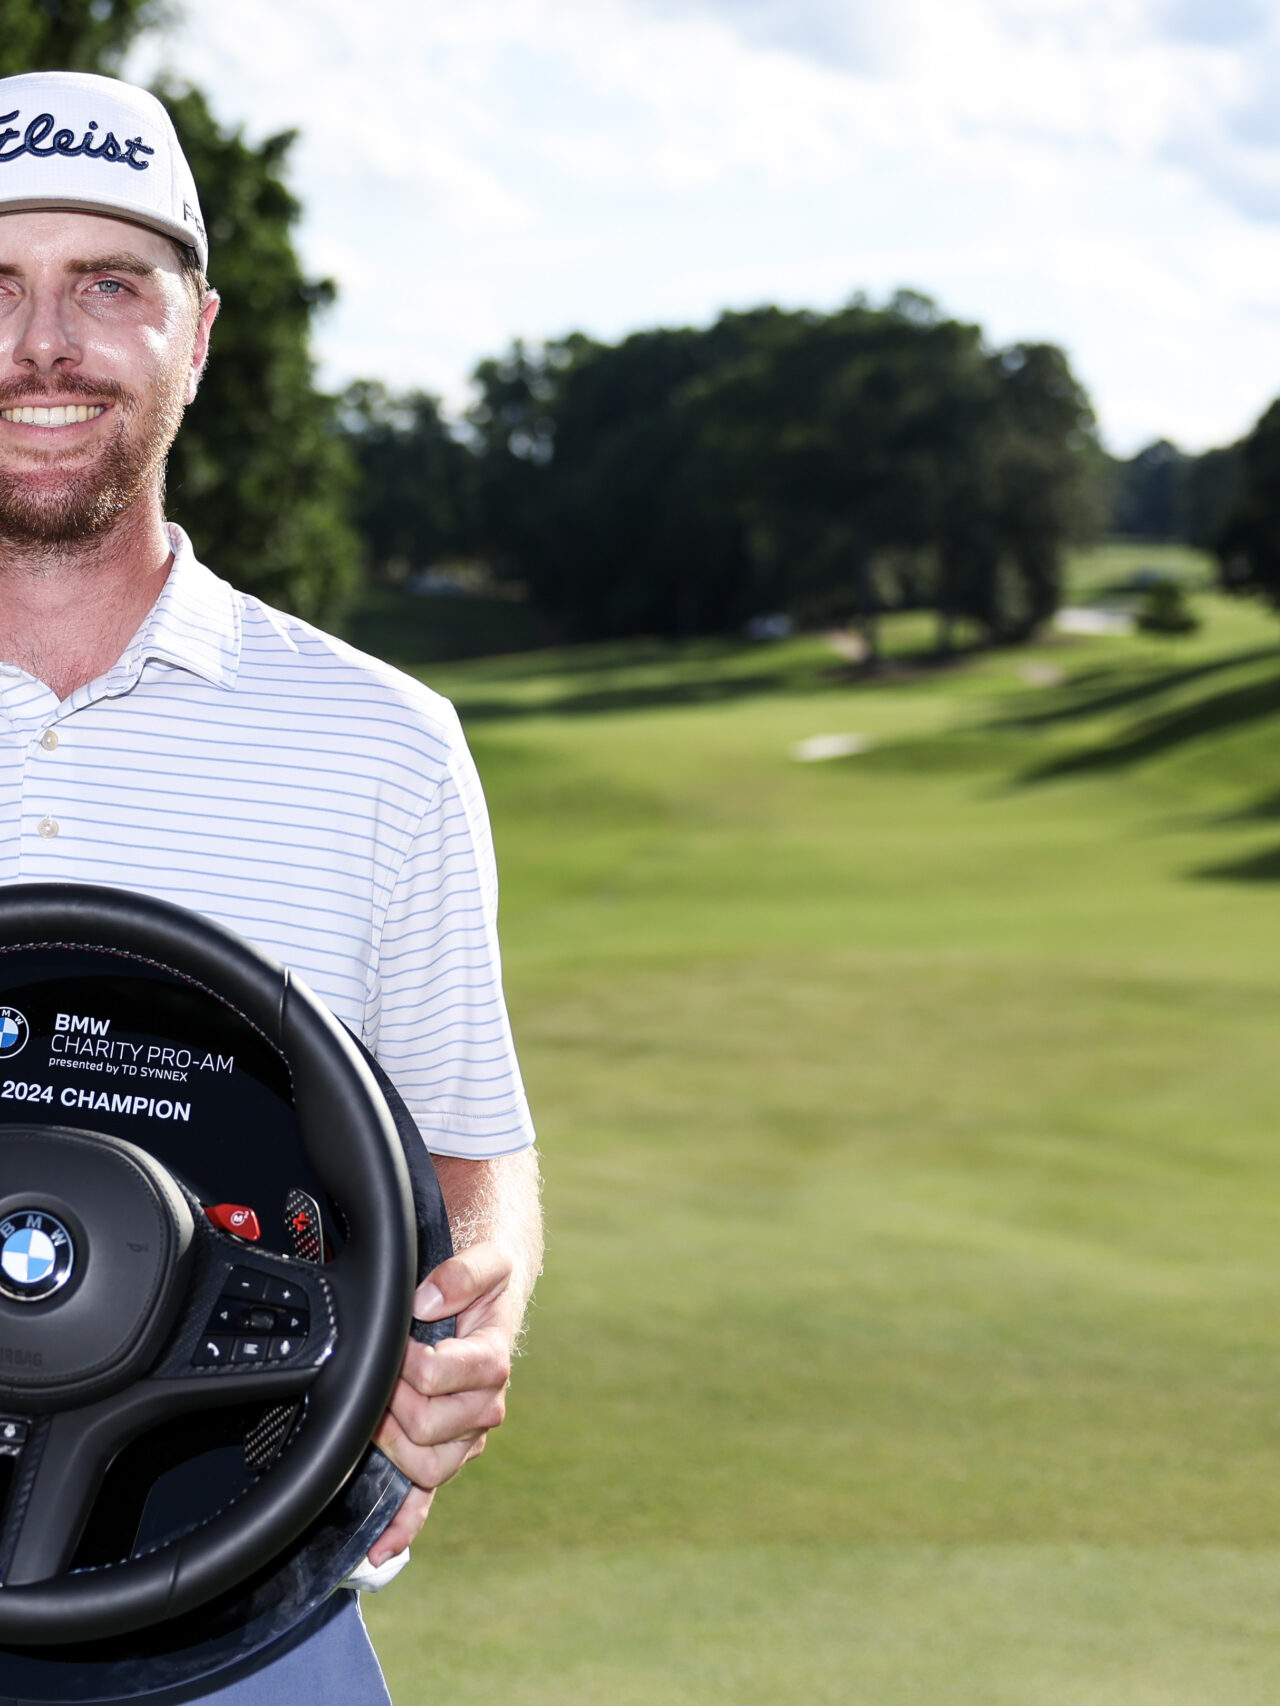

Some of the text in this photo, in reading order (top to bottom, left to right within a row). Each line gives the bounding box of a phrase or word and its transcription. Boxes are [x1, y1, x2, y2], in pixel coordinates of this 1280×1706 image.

[55, 1013, 110, 1036] BMW
[48, 1057, 188, 1082] presented by TD SYNNEX
[51, 1034, 234, 1073] CHARITY PRO-AM
[1, 1080, 191, 1121] 2024 CHAMPION
[0, 1214, 66, 1247] BMW
